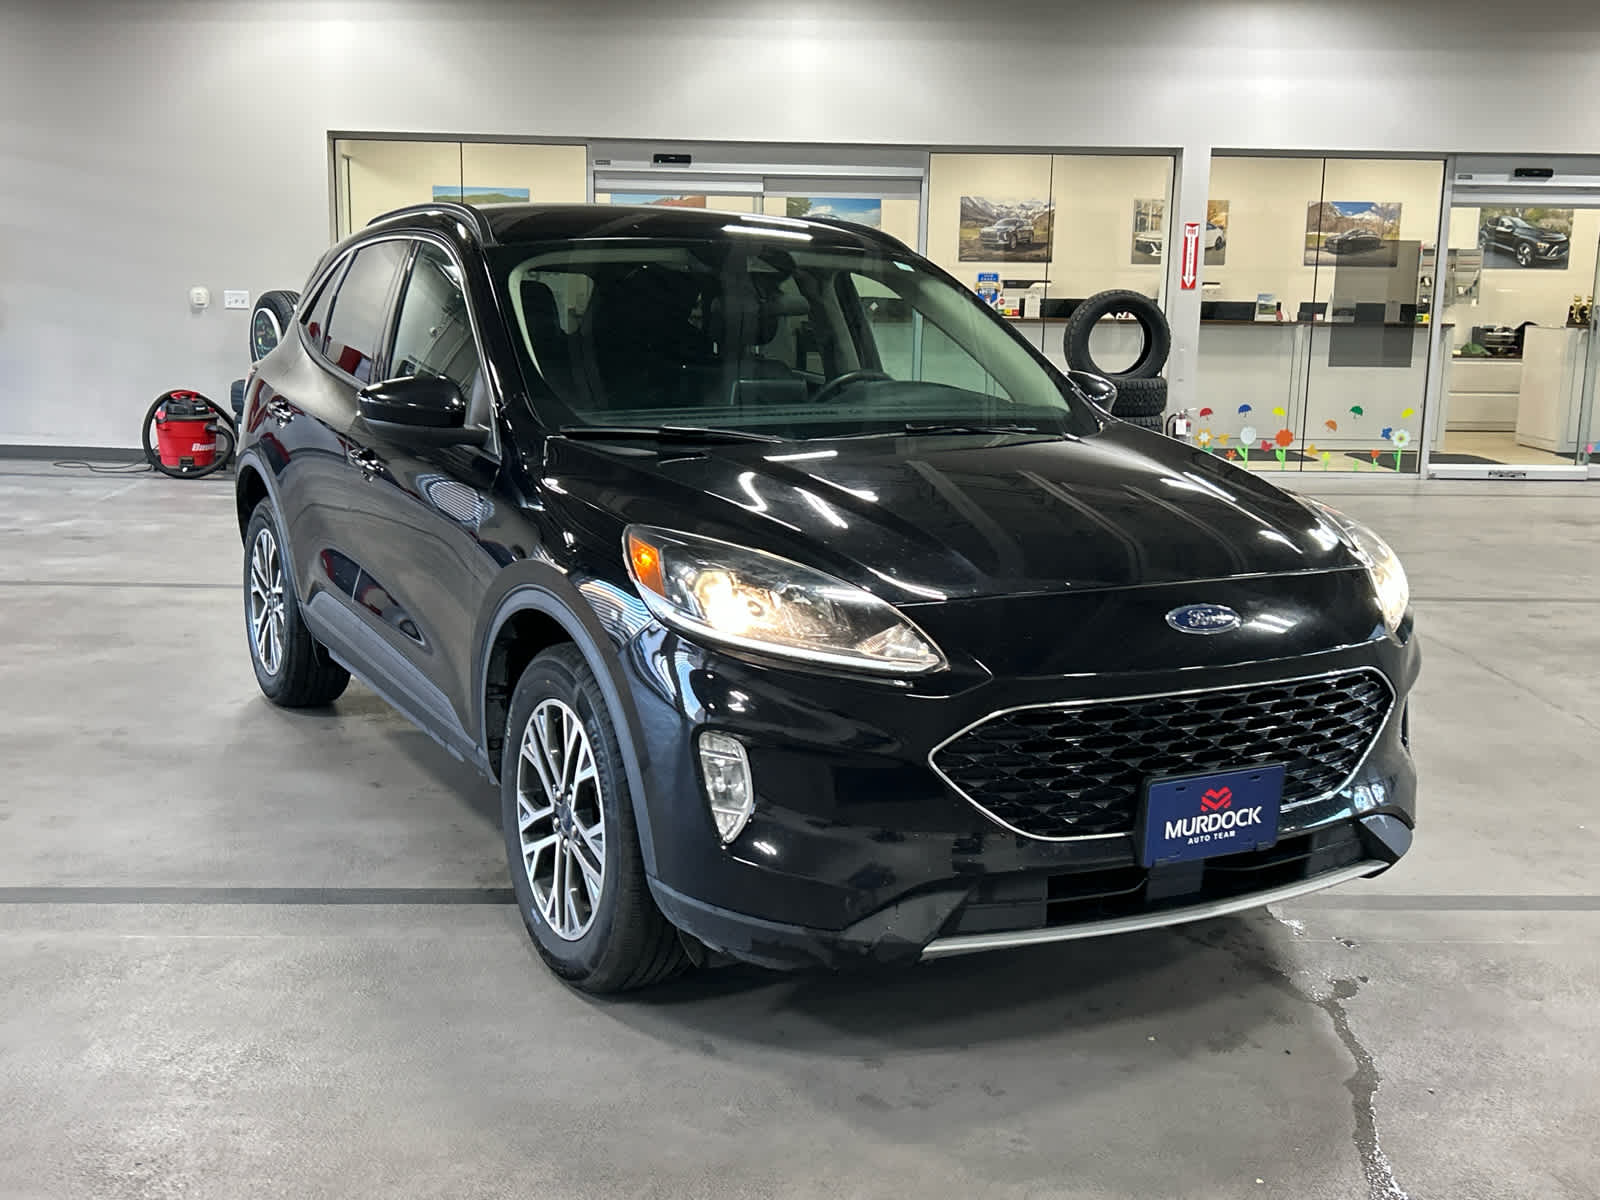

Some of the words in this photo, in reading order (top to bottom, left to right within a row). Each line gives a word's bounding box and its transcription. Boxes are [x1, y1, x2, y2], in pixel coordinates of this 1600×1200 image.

[1164, 805, 1263, 840] MURDOCK
[1187, 835, 1211, 845] AUTO
[1213, 830, 1236, 841] TEAM
